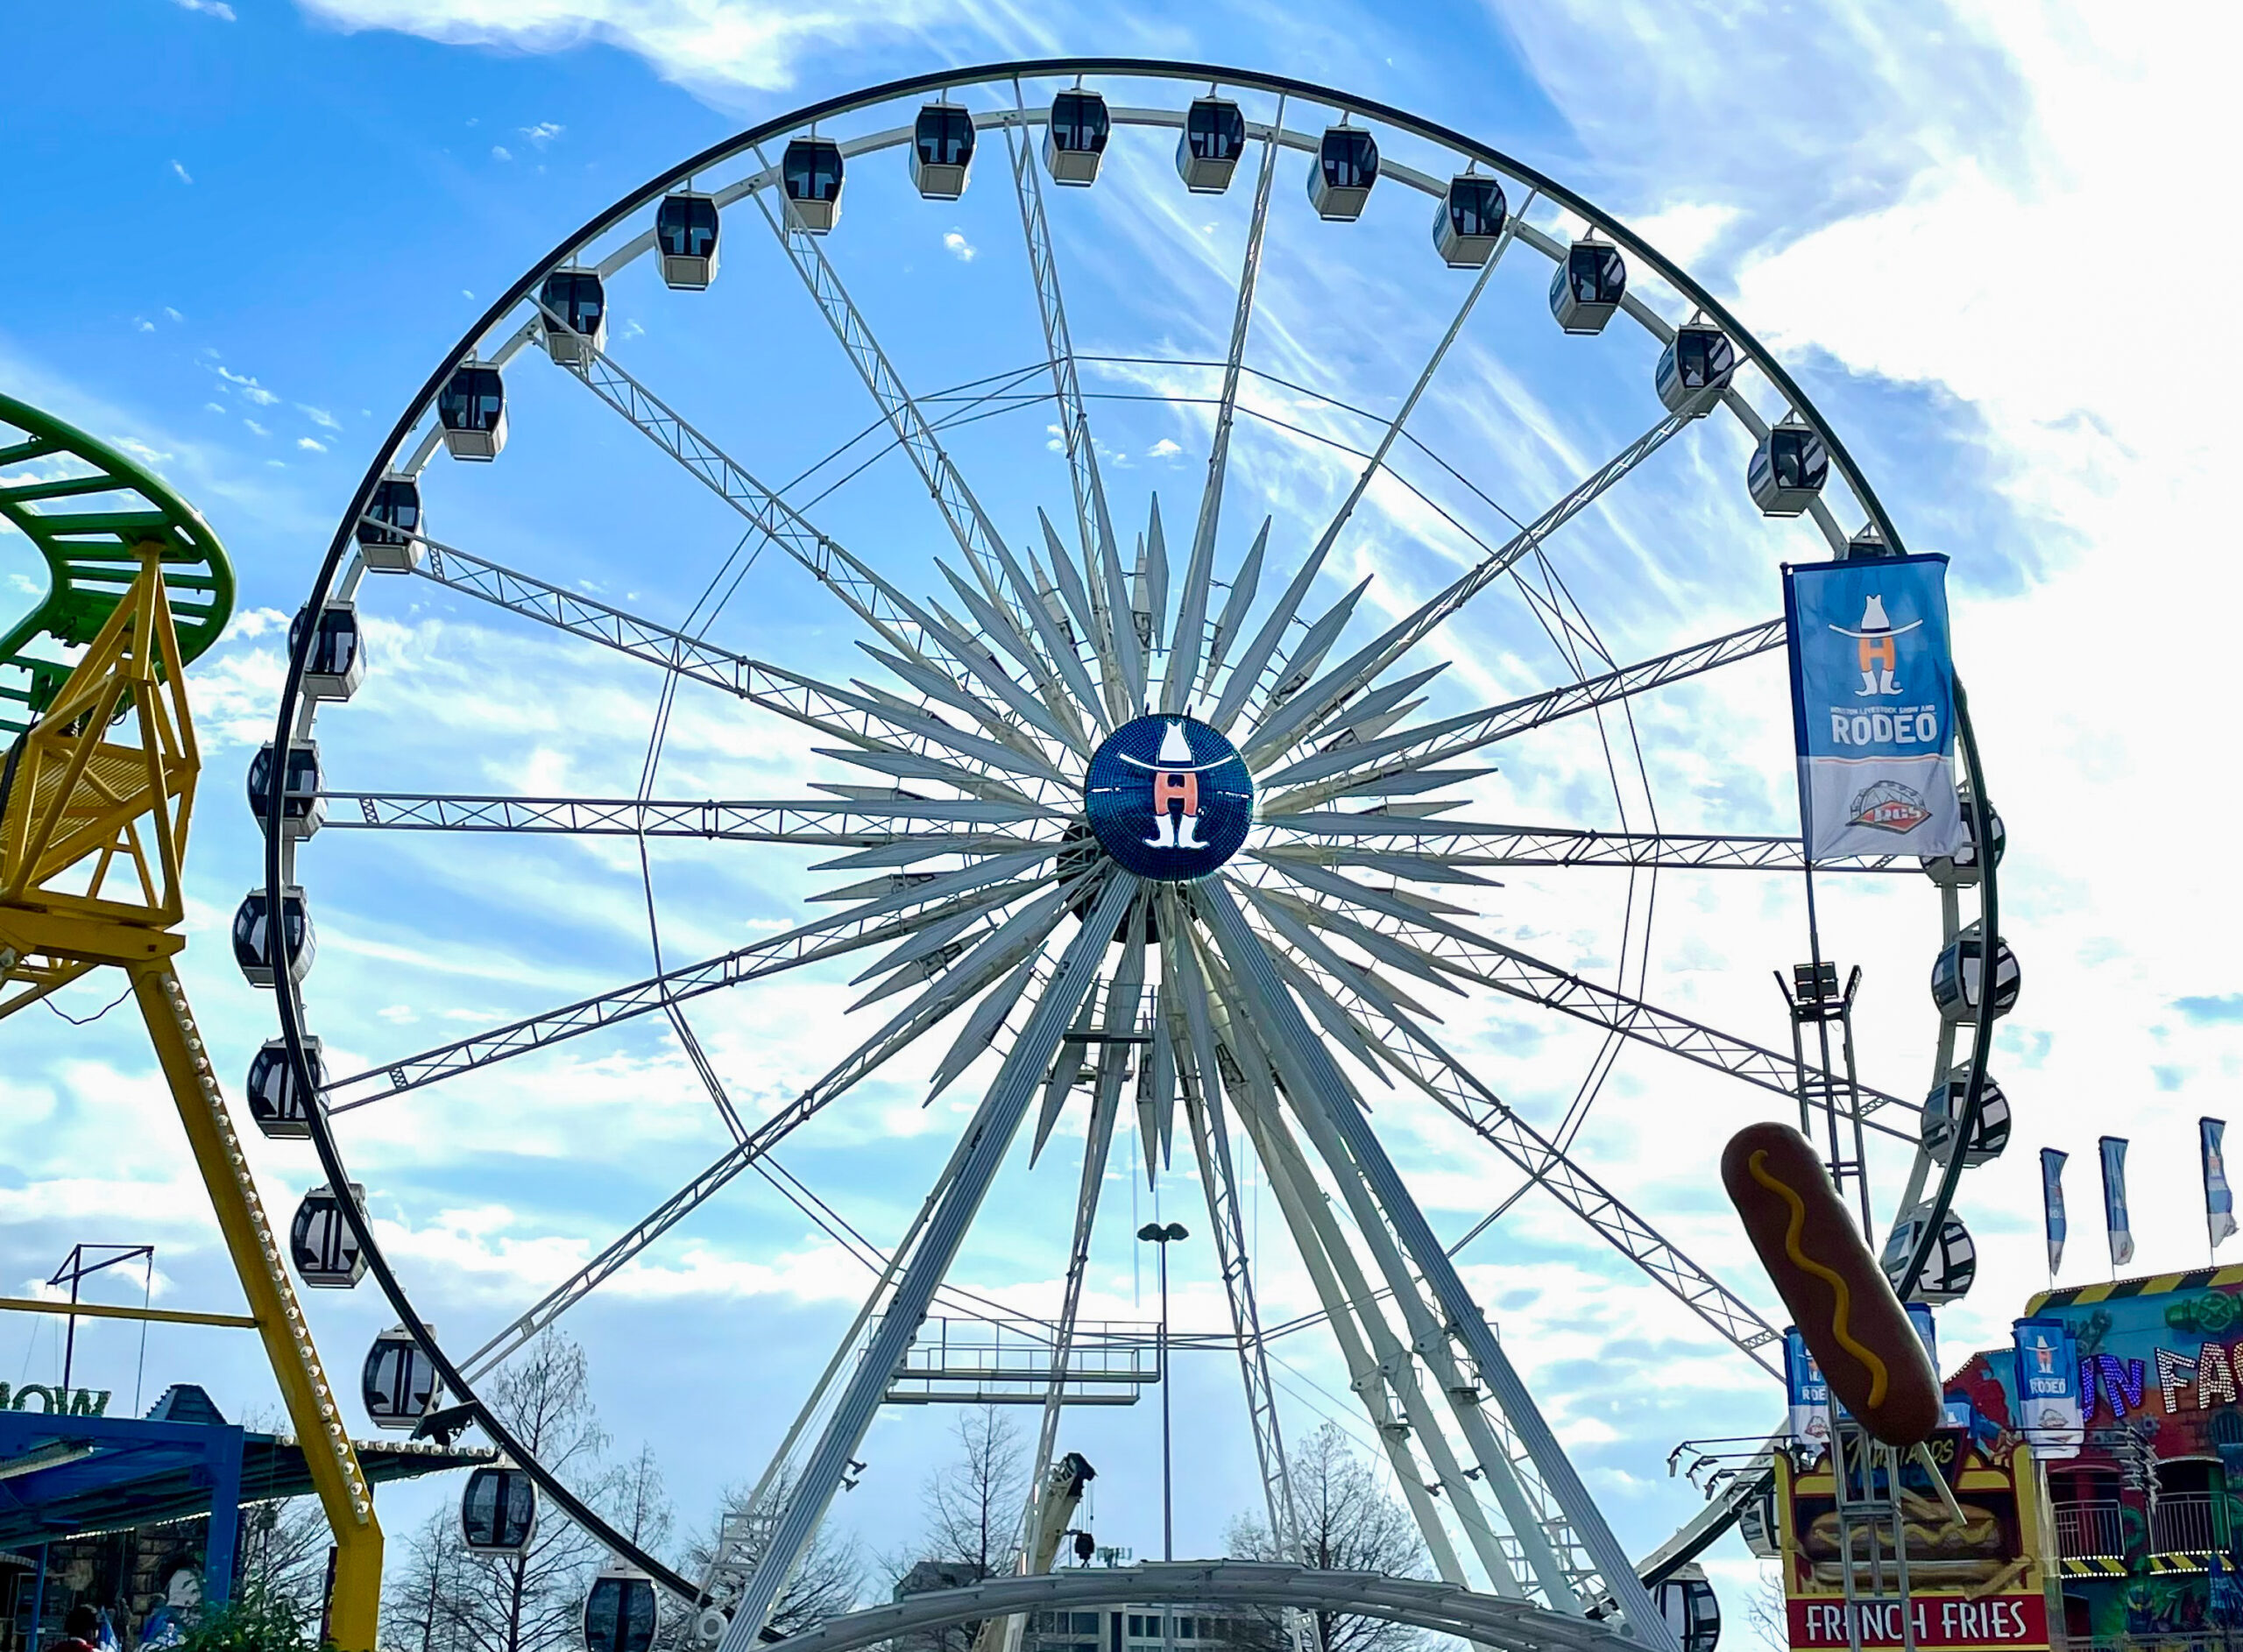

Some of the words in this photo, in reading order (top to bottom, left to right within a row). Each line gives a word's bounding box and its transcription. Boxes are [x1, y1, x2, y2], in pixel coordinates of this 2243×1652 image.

[1831, 713, 1937, 745] RODEO
[2029, 1380, 2066, 1394] RODEO
[2155, 1341, 2243, 1414] FA
[1942, 1600, 2027, 1639] FRIES
